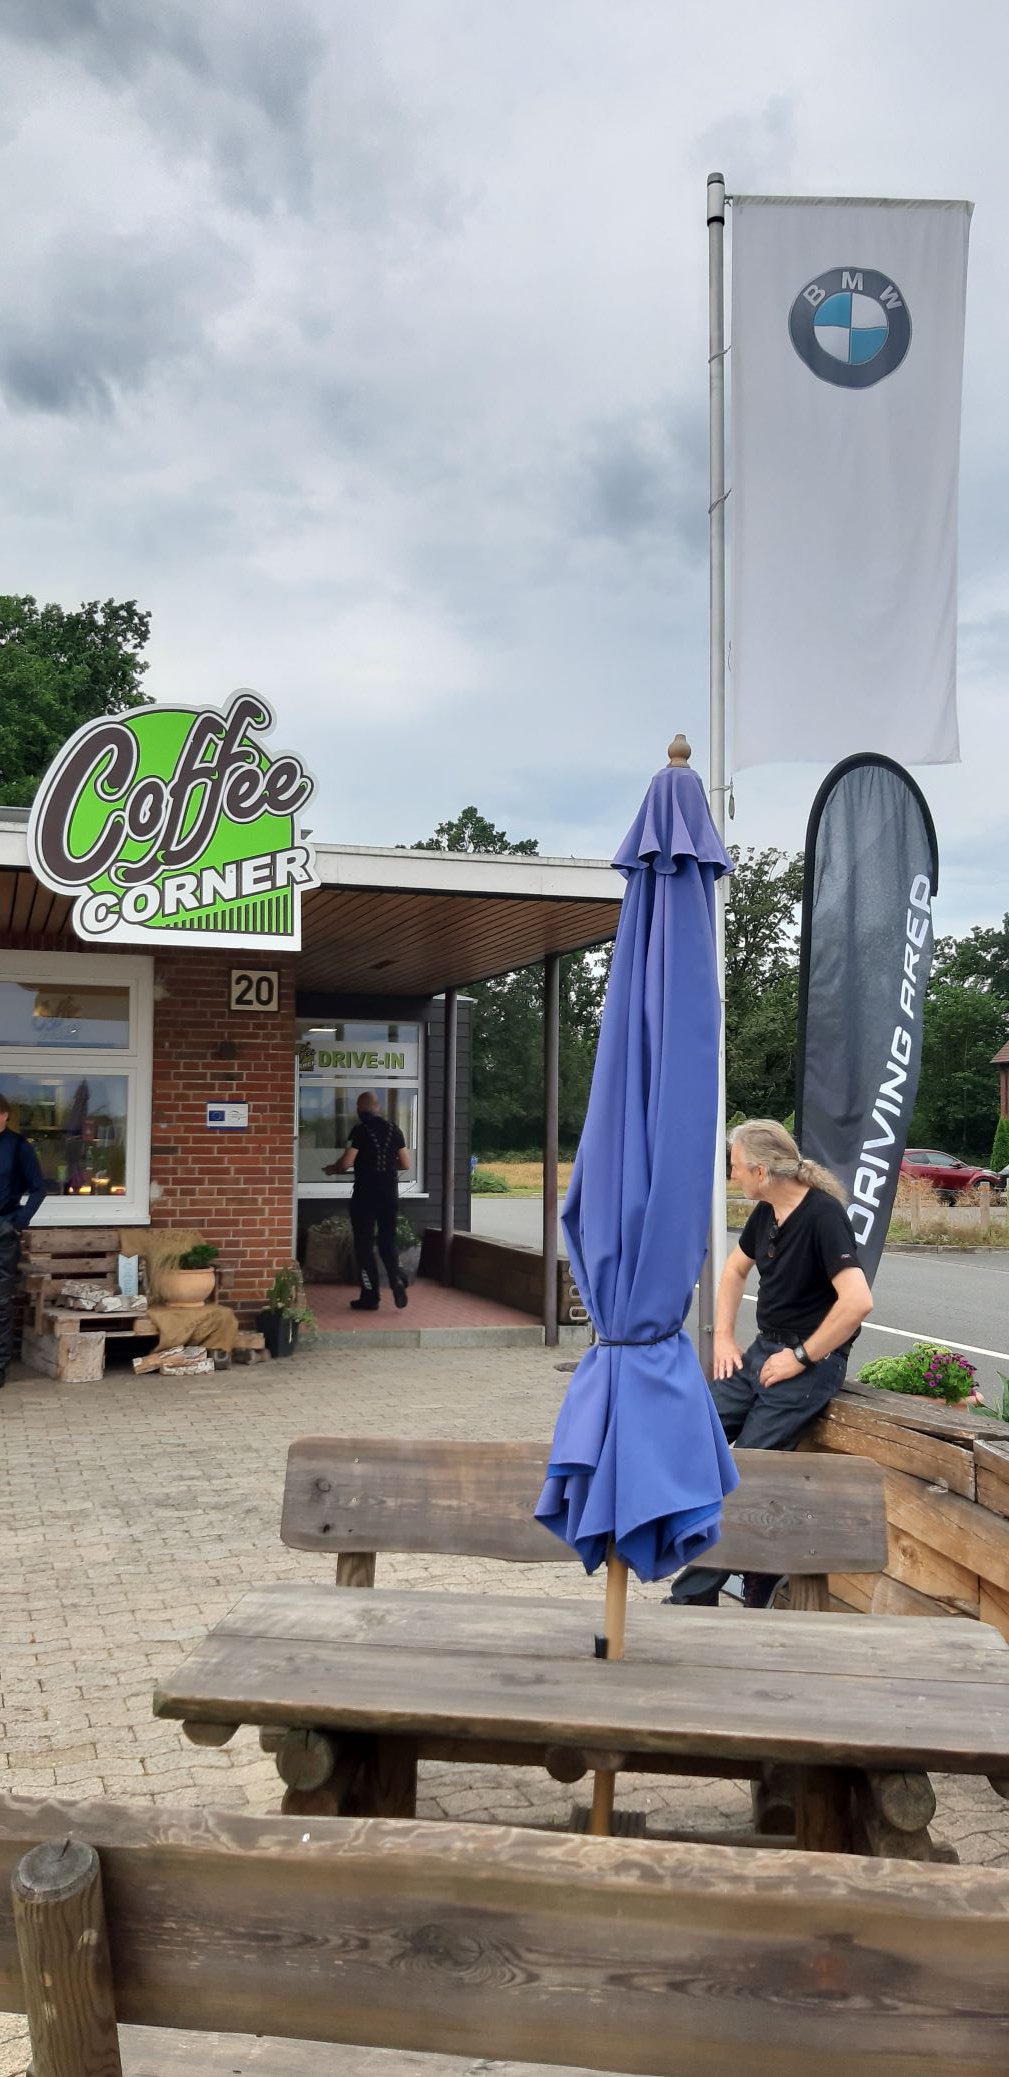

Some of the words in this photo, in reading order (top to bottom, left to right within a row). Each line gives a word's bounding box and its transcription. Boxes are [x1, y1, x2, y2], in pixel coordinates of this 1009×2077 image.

[803, 271, 902, 310] BMW
[38, 696, 313, 886] Coffee
[82, 848, 313, 932] CORNER
[235, 974, 274, 1006] 20
[318, 1050, 405, 1070] DRIVE-IN
[846, 1026, 912, 1246] DRIVING
[900, 873, 931, 1020] AREA
